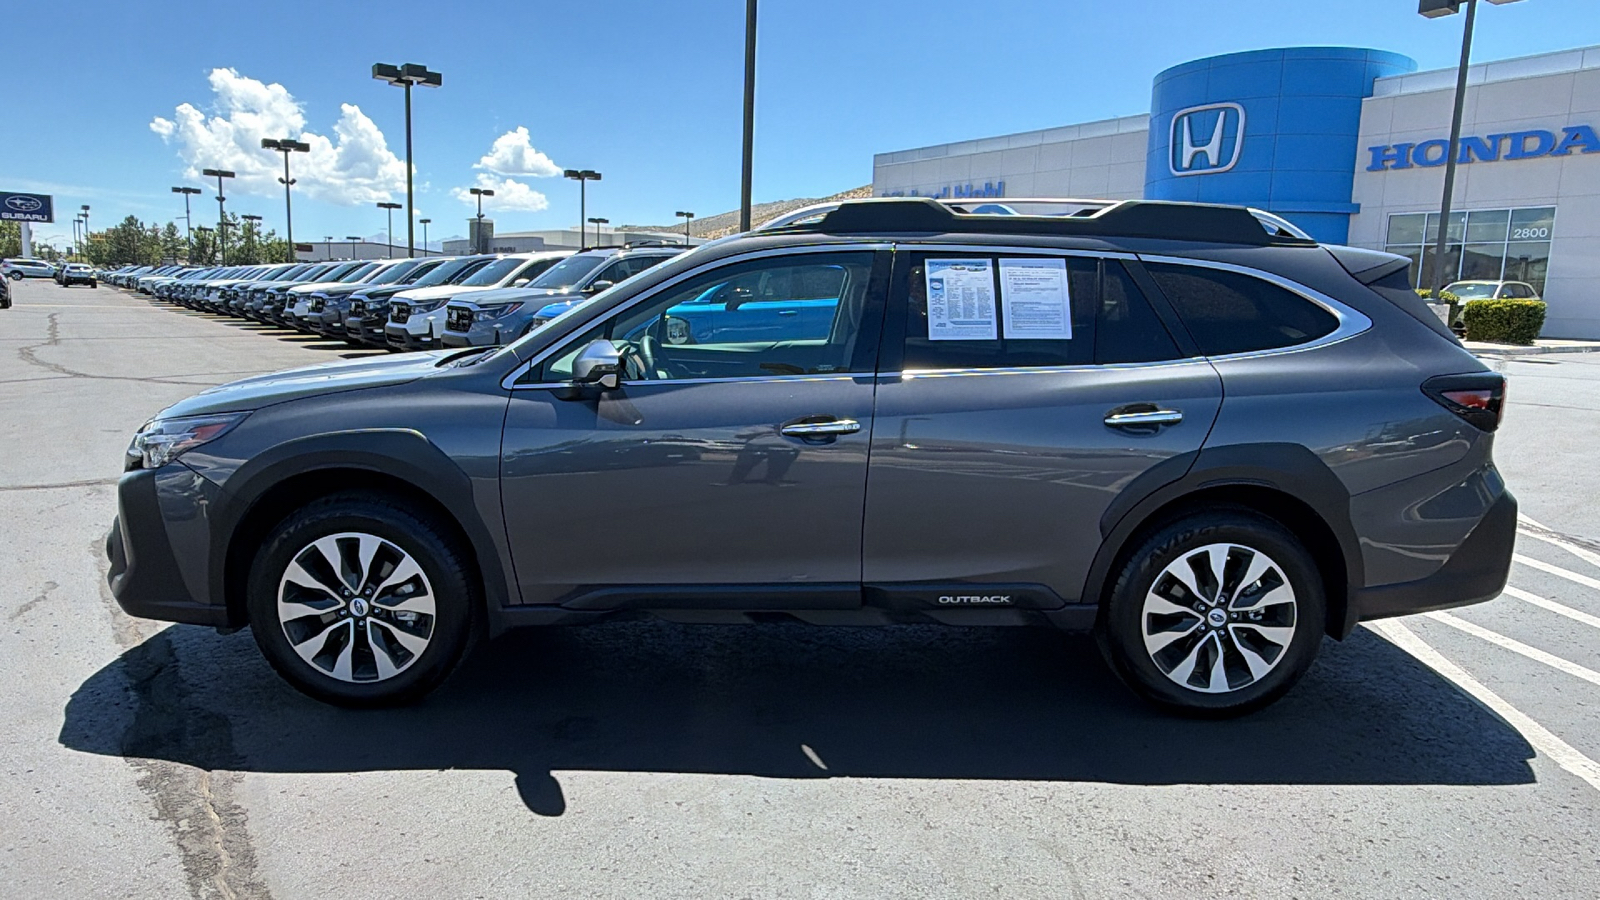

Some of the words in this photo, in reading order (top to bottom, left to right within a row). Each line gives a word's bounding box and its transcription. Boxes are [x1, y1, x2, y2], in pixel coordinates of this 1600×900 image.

[1366, 125, 1600, 171] HONDA
[1, 212, 48, 220] SUBARU
[1513, 227, 1548, 238] 2800
[938, 595, 1011, 604] OUTBACK
